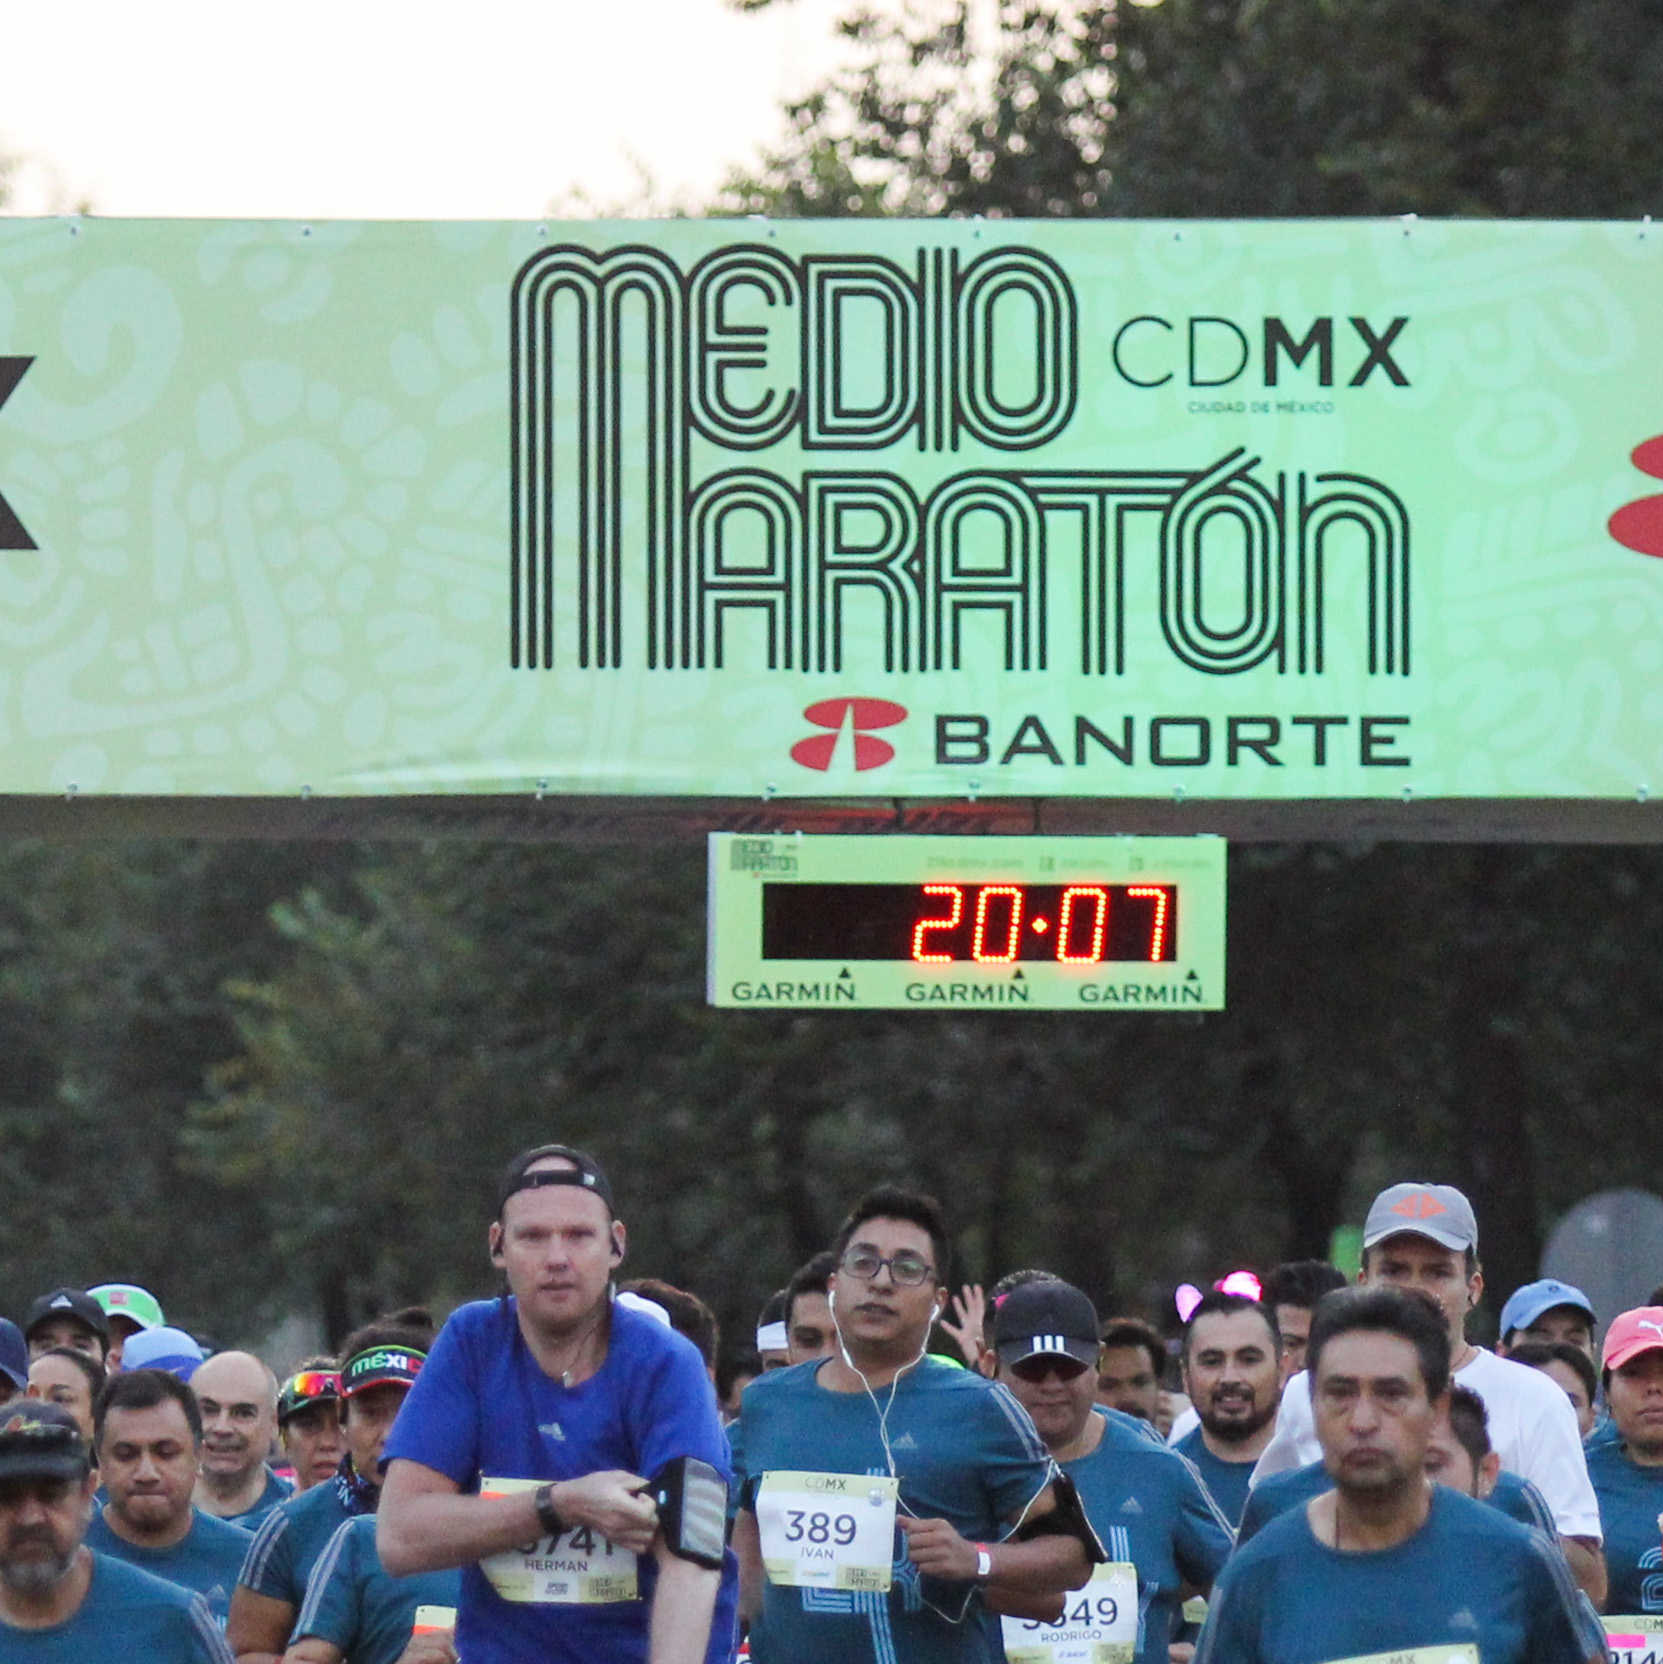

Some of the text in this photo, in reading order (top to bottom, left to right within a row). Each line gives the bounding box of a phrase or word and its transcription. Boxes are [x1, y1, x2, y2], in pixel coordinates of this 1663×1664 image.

[511, 243, 1079, 455] MEDIO
[1112, 315, 1411, 388] CDMX
[1188, 400, 1246, 414] CIUDAD
[1250, 400, 1270, 414] DE
[511, 446, 1411, 675] MARATÓN
[934, 714, 1412, 768] BANORTE
[731, 981, 857, 1002] GARMIN
[905, 982, 1029, 1003] GARMIN
[1078, 983, 1204, 1003] GARMIN
[804, 1478, 847, 1492] CDMX
[784, 1508, 857, 1546] 389
[800, 1546, 834, 1560] IVAN
[523, 1559, 589, 1572] HERMAN
[1041, 1629, 1103, 1643] RODRIGO
